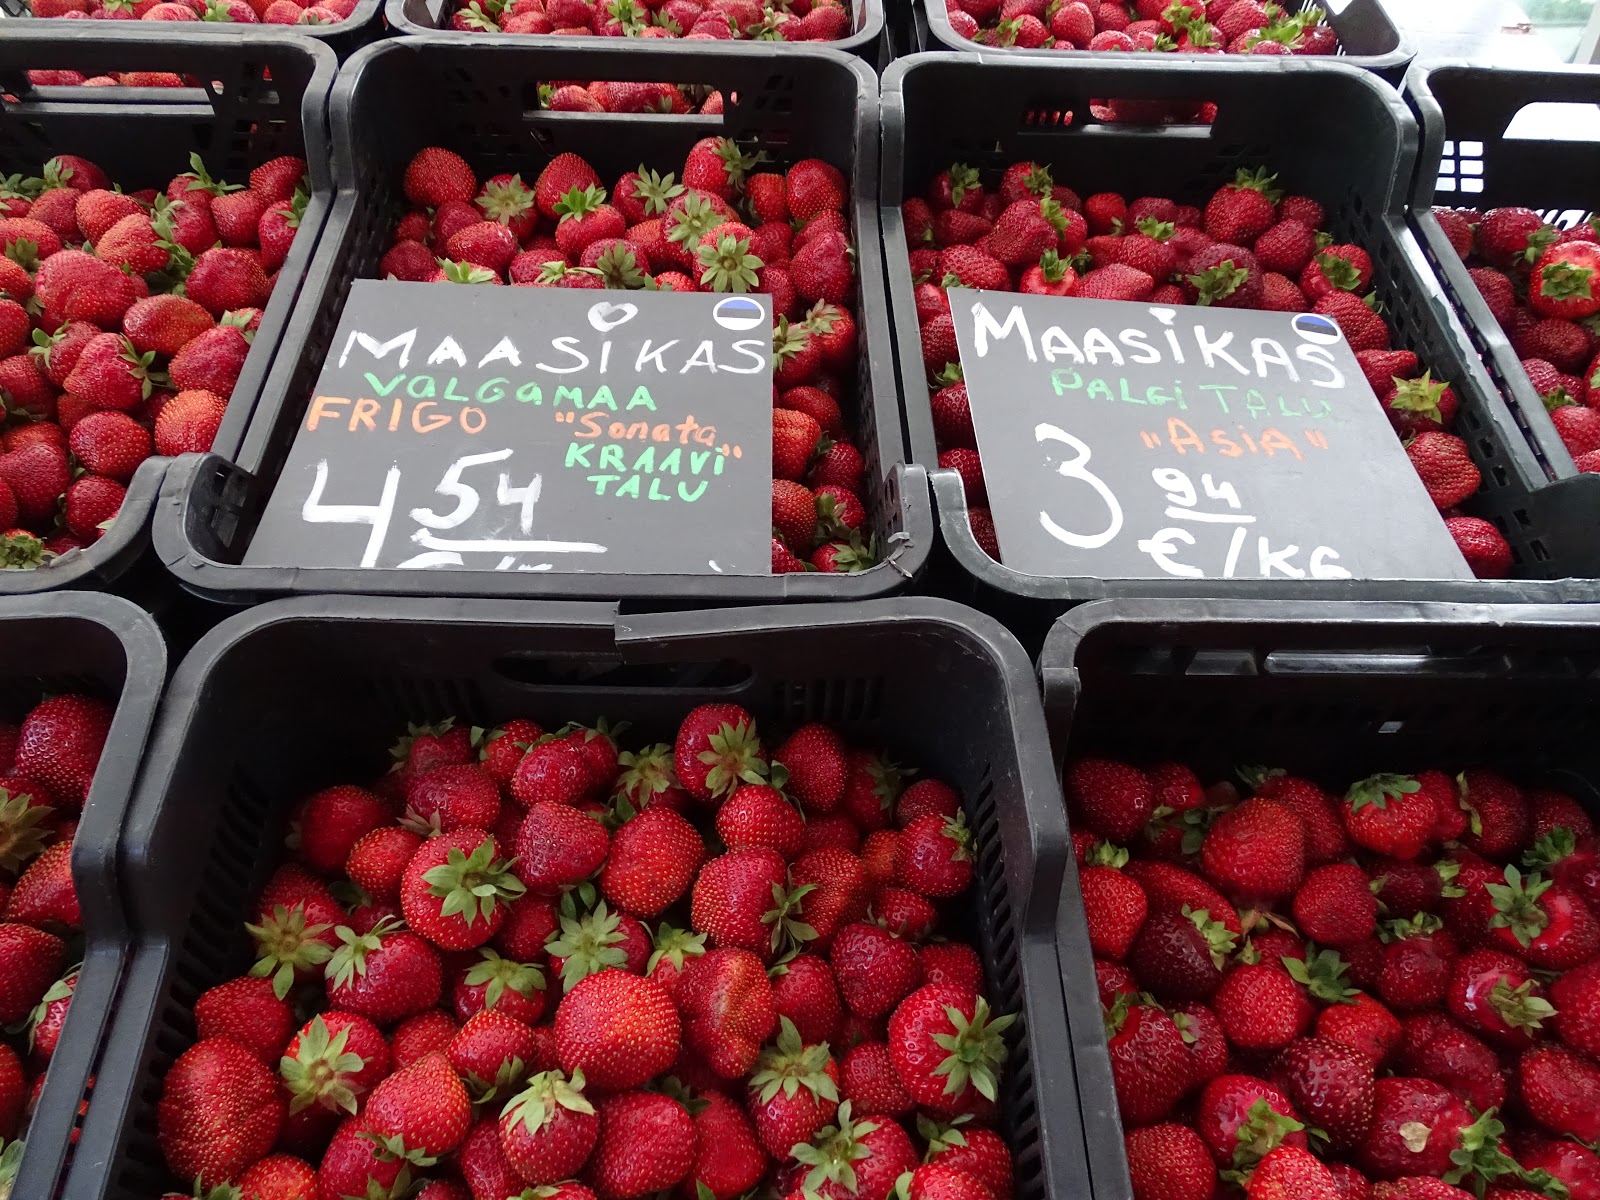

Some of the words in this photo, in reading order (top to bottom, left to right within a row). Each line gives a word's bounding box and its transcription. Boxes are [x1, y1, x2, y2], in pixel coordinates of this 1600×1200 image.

[306, 396, 487, 434] FRIGO
[1199, 384, 1333, 419] TALU
[587, 474, 708, 502] TALU
[1035, 422, 1123, 549] 3
[1152, 468, 1242, 509] 94
[302, 459, 401, 568] 4
[409, 448, 543, 535] 54
